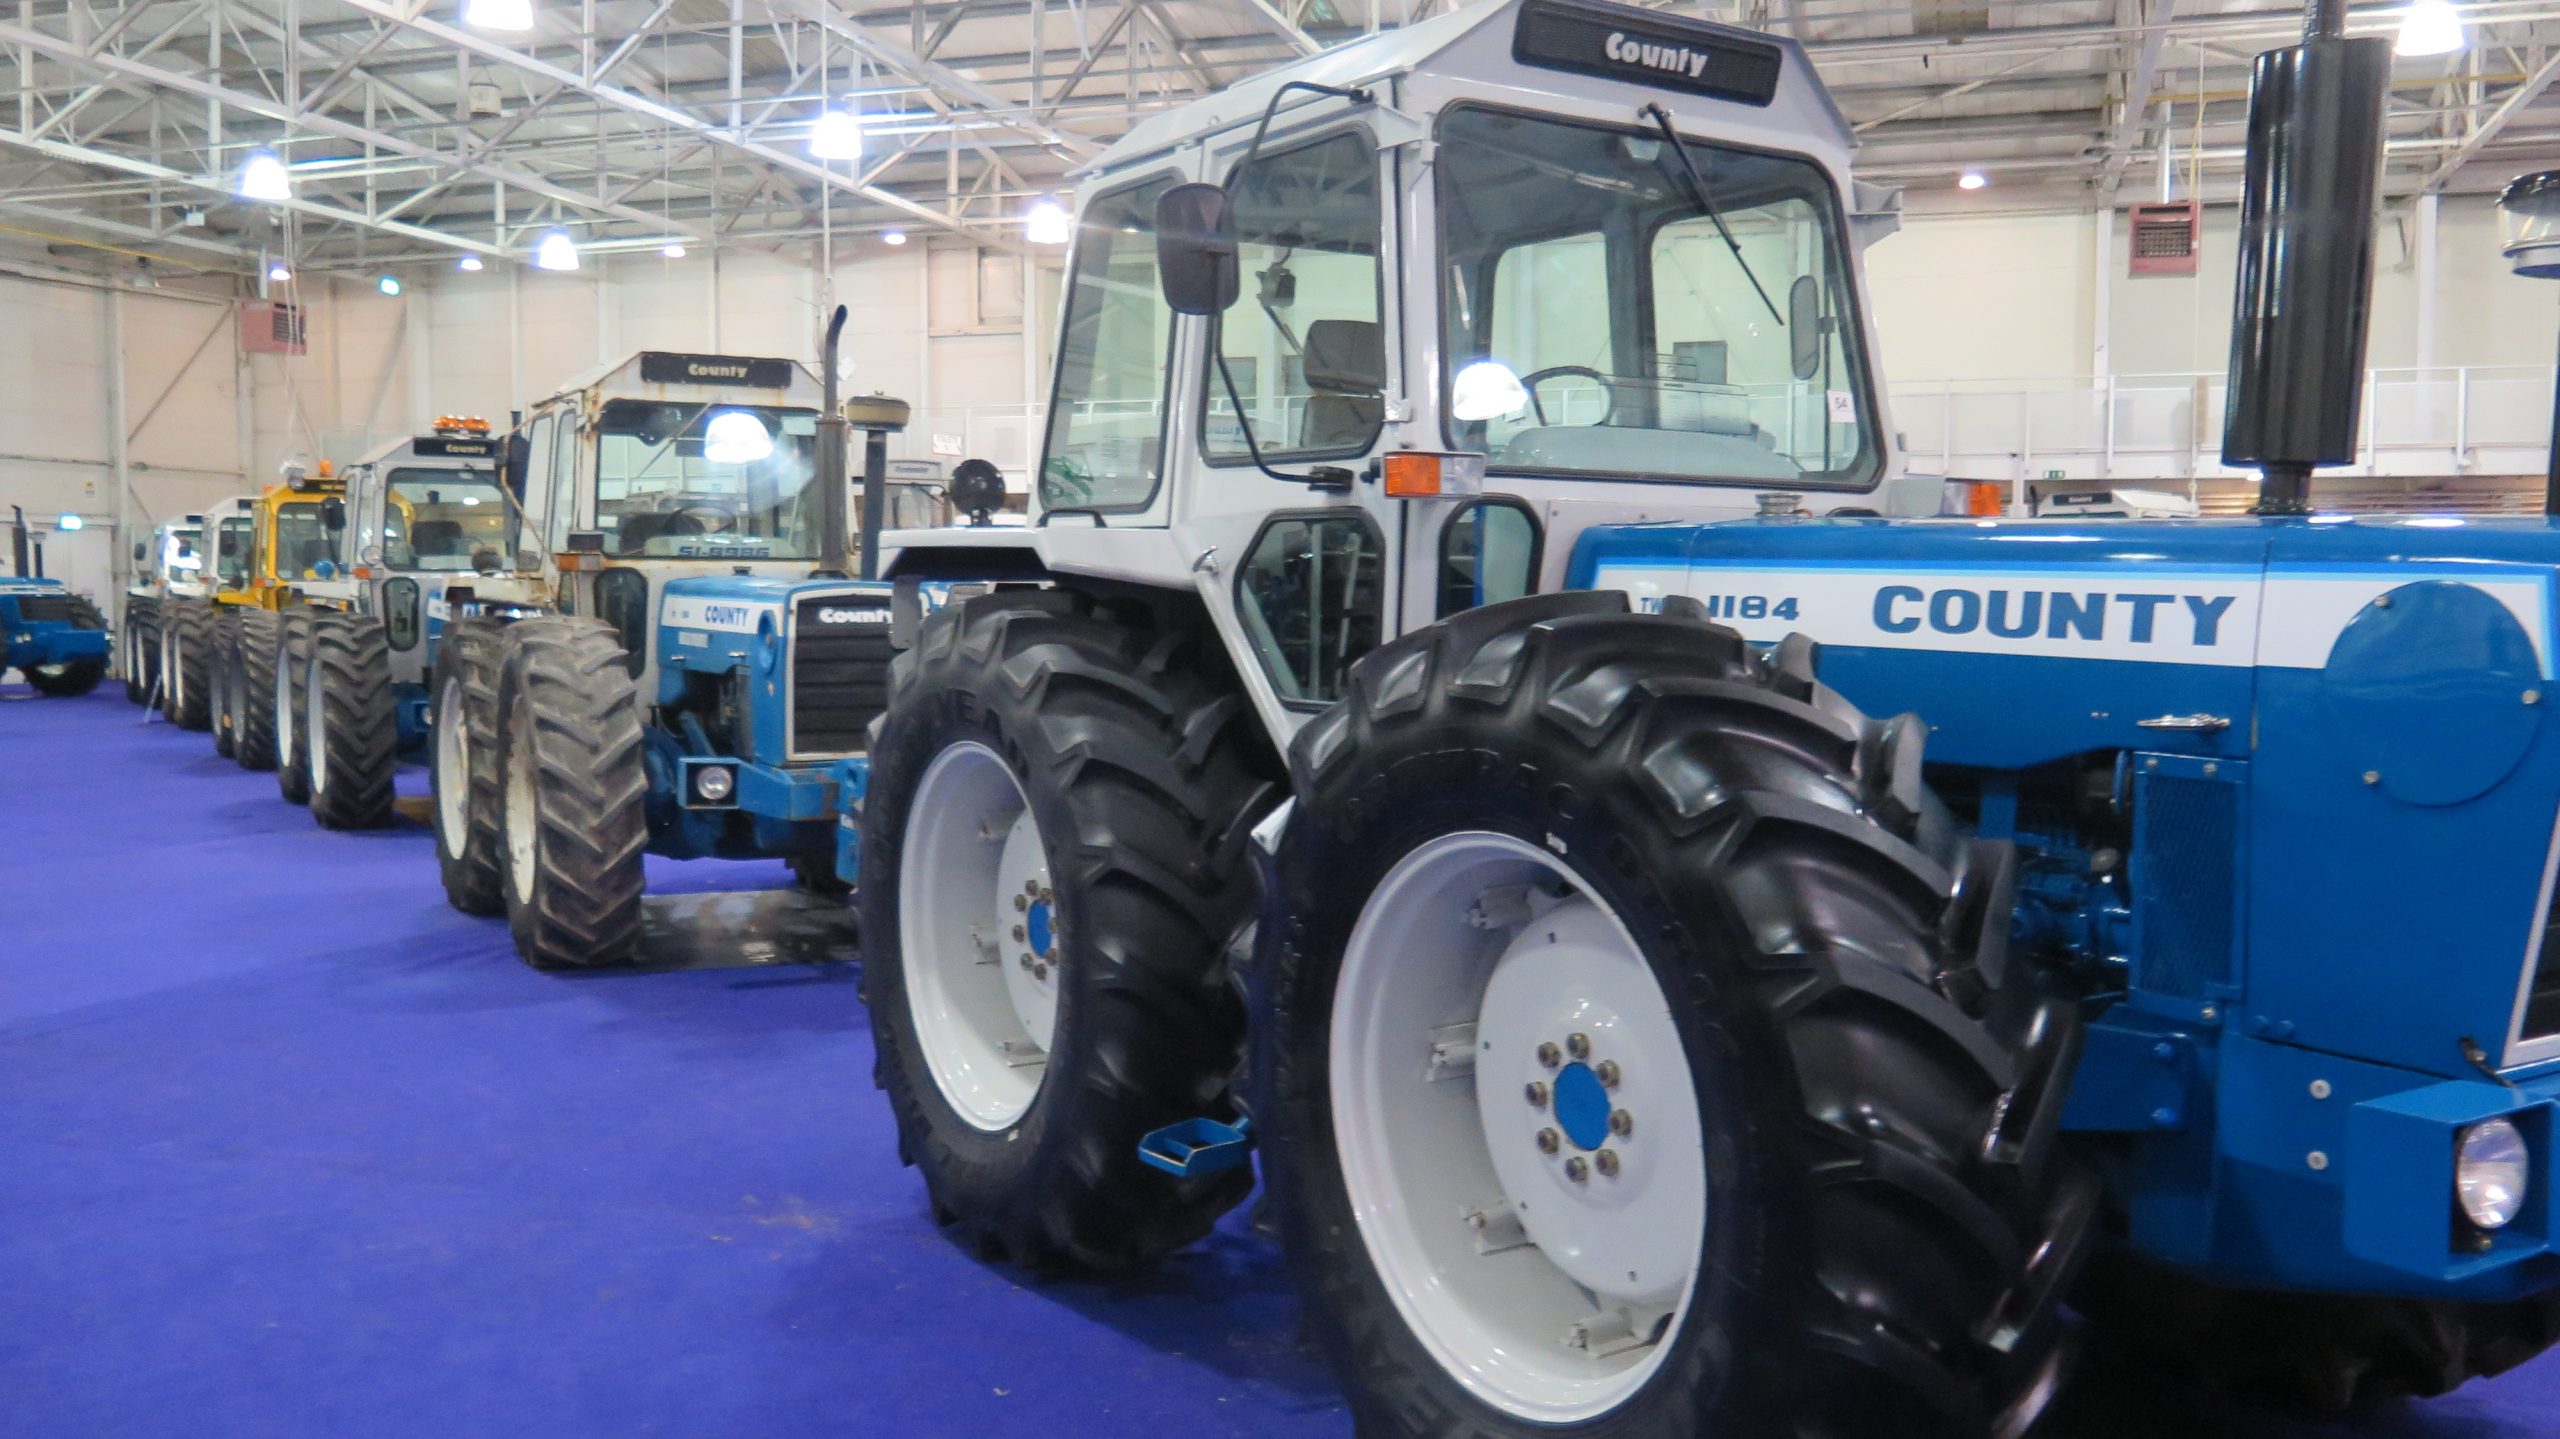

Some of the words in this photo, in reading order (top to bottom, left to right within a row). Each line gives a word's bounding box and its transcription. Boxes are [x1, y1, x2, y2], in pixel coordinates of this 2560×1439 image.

[1605, 32, 1708, 77] County
[687, 363, 747, 378] County
[705, 606, 749, 626] COUNTY
[1707, 595, 1799, 621] 1184
[1873, 584, 2238, 646] COUNTY
